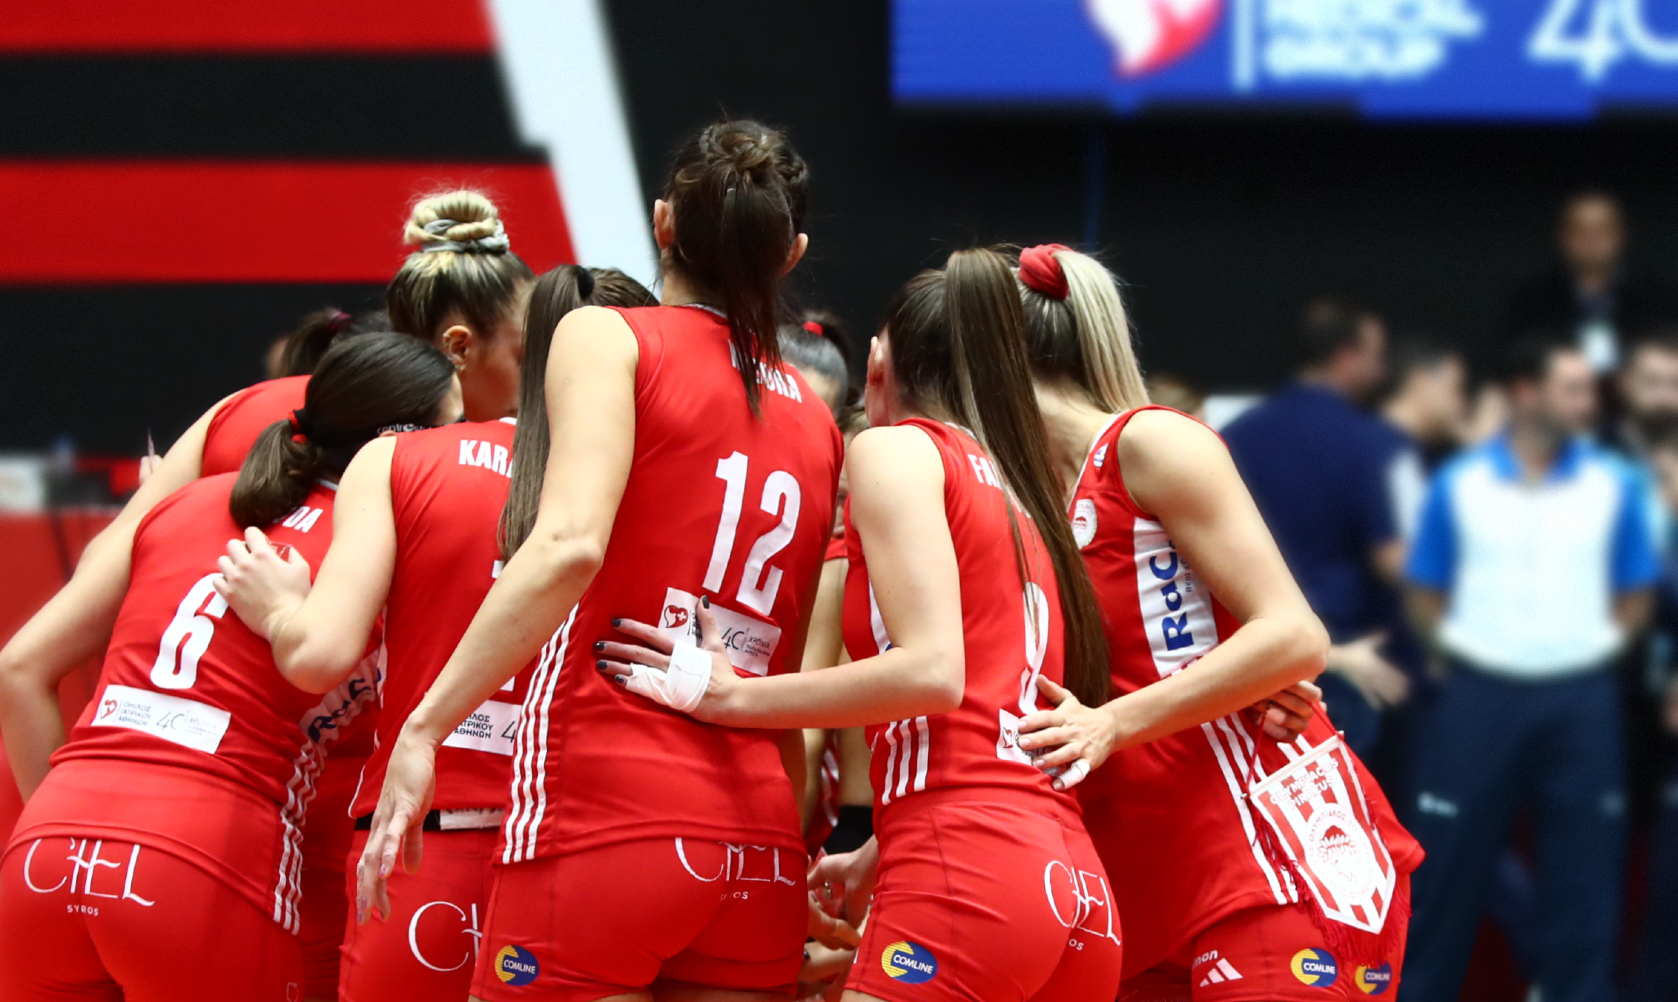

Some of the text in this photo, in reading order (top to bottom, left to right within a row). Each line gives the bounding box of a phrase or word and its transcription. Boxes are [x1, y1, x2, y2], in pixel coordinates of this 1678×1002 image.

[702, 450, 801, 616] 12
[1149, 541, 1194, 651] RaC
[150, 573, 229, 690] 6
[1269, 758, 1339, 806] OLYMPIACOS
[1287, 775, 1335, 811] PIRAEUS
[67, 904, 99, 916] SYROS
[503, 959, 536, 974] COMLINE
[893, 954, 934, 974] COMLINE
[1303, 962, 1335, 975] COMLINE
